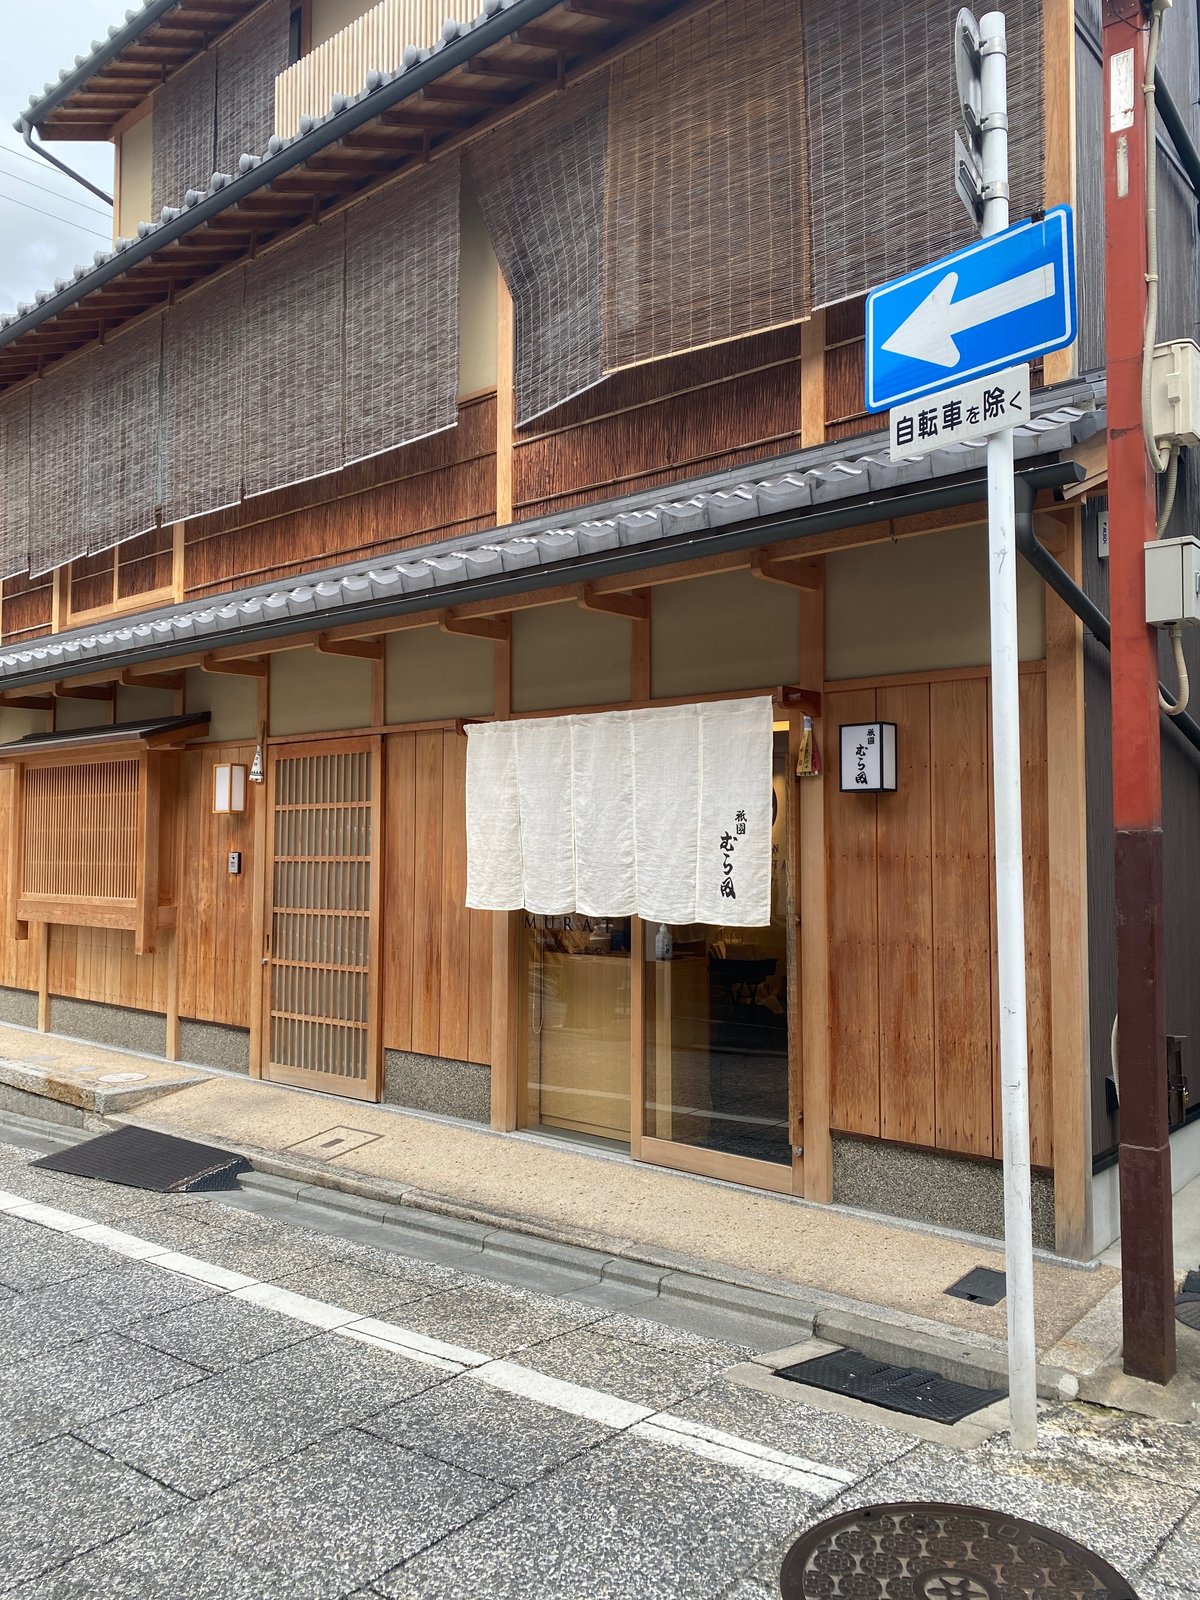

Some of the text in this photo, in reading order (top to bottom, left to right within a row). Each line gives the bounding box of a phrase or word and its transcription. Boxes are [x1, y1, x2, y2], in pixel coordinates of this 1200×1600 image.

[897, 386, 1023, 446] 自転車を除く
